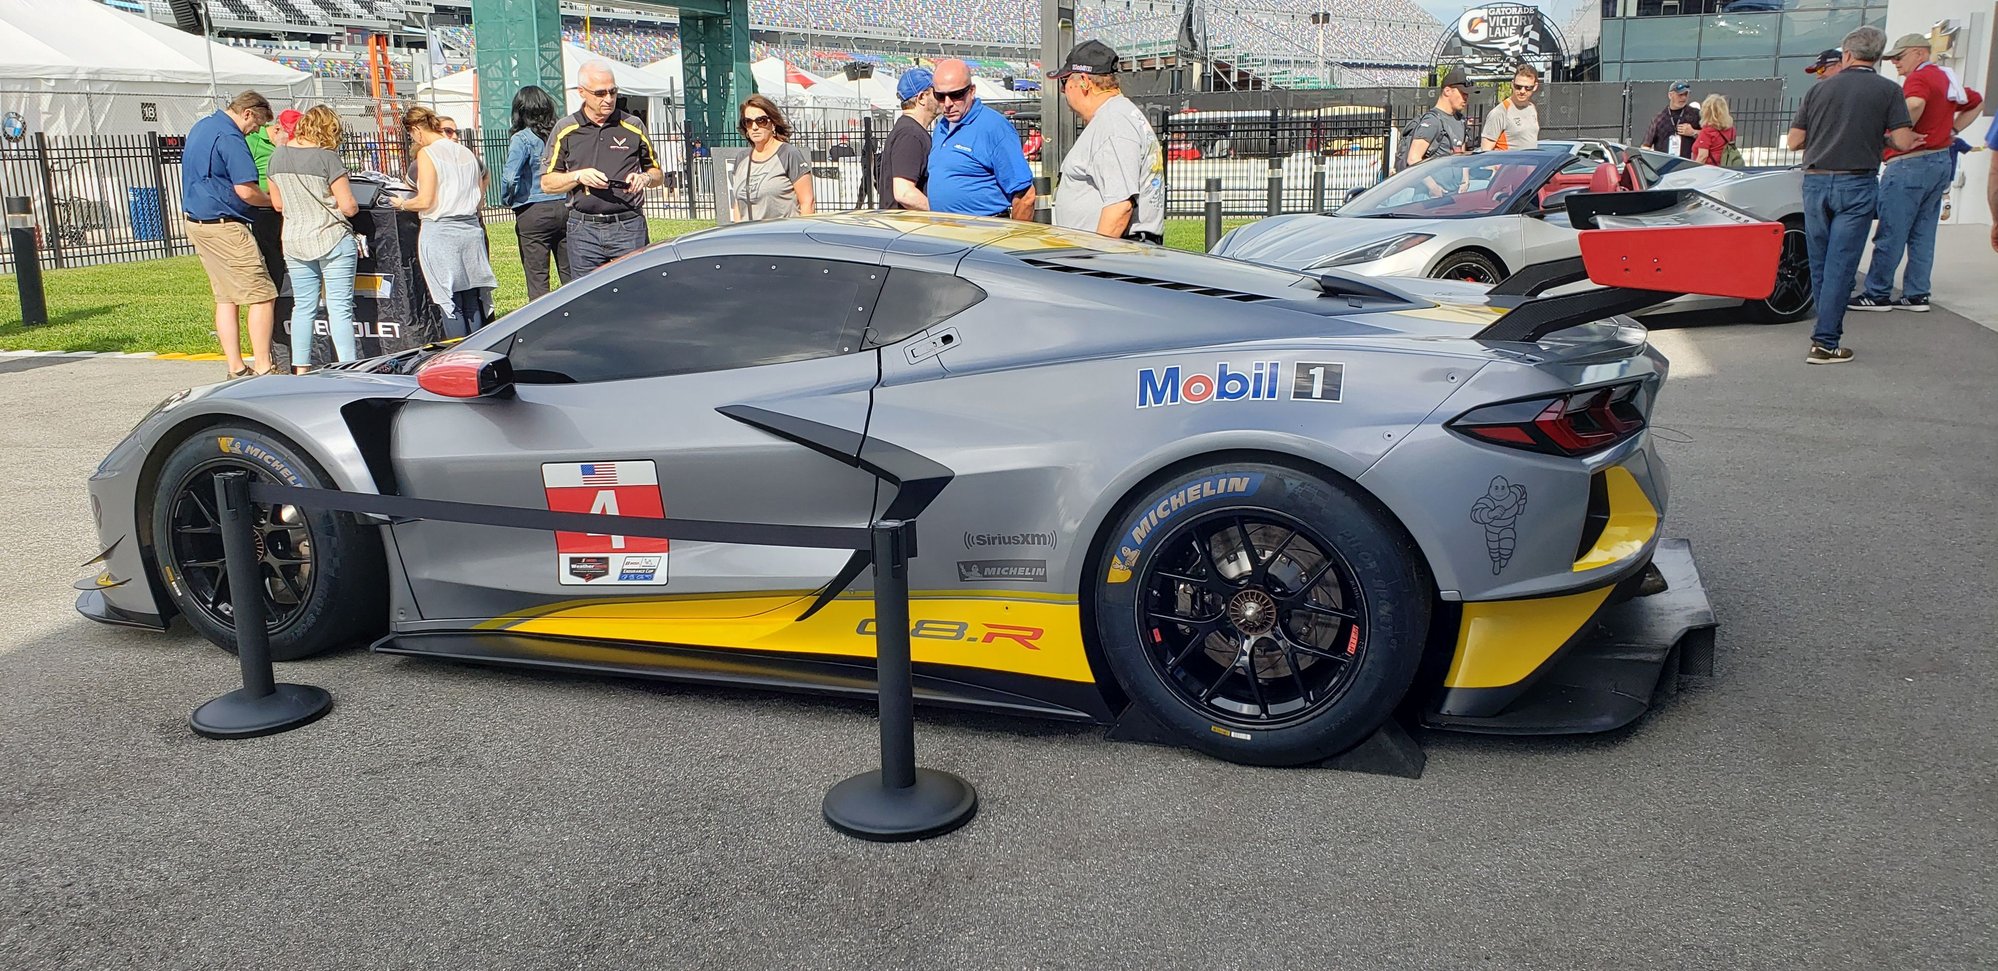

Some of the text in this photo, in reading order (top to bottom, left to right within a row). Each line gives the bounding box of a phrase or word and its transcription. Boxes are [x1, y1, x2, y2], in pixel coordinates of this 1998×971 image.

[1488, 7, 1535, 16] GATORADE
[1489, 16, 1535, 27] VICTORY
[1488, 27, 1517, 38] LANE
[144, 106, 155, 118] 18
[1136, 361, 1280, 408] Mobil
[245, 445, 304, 487] MICHEL
[1131, 477, 1250, 545] MICHELIN
[586, 489, 625, 549] 4
[983, 567, 1046, 577] MICHELIN
